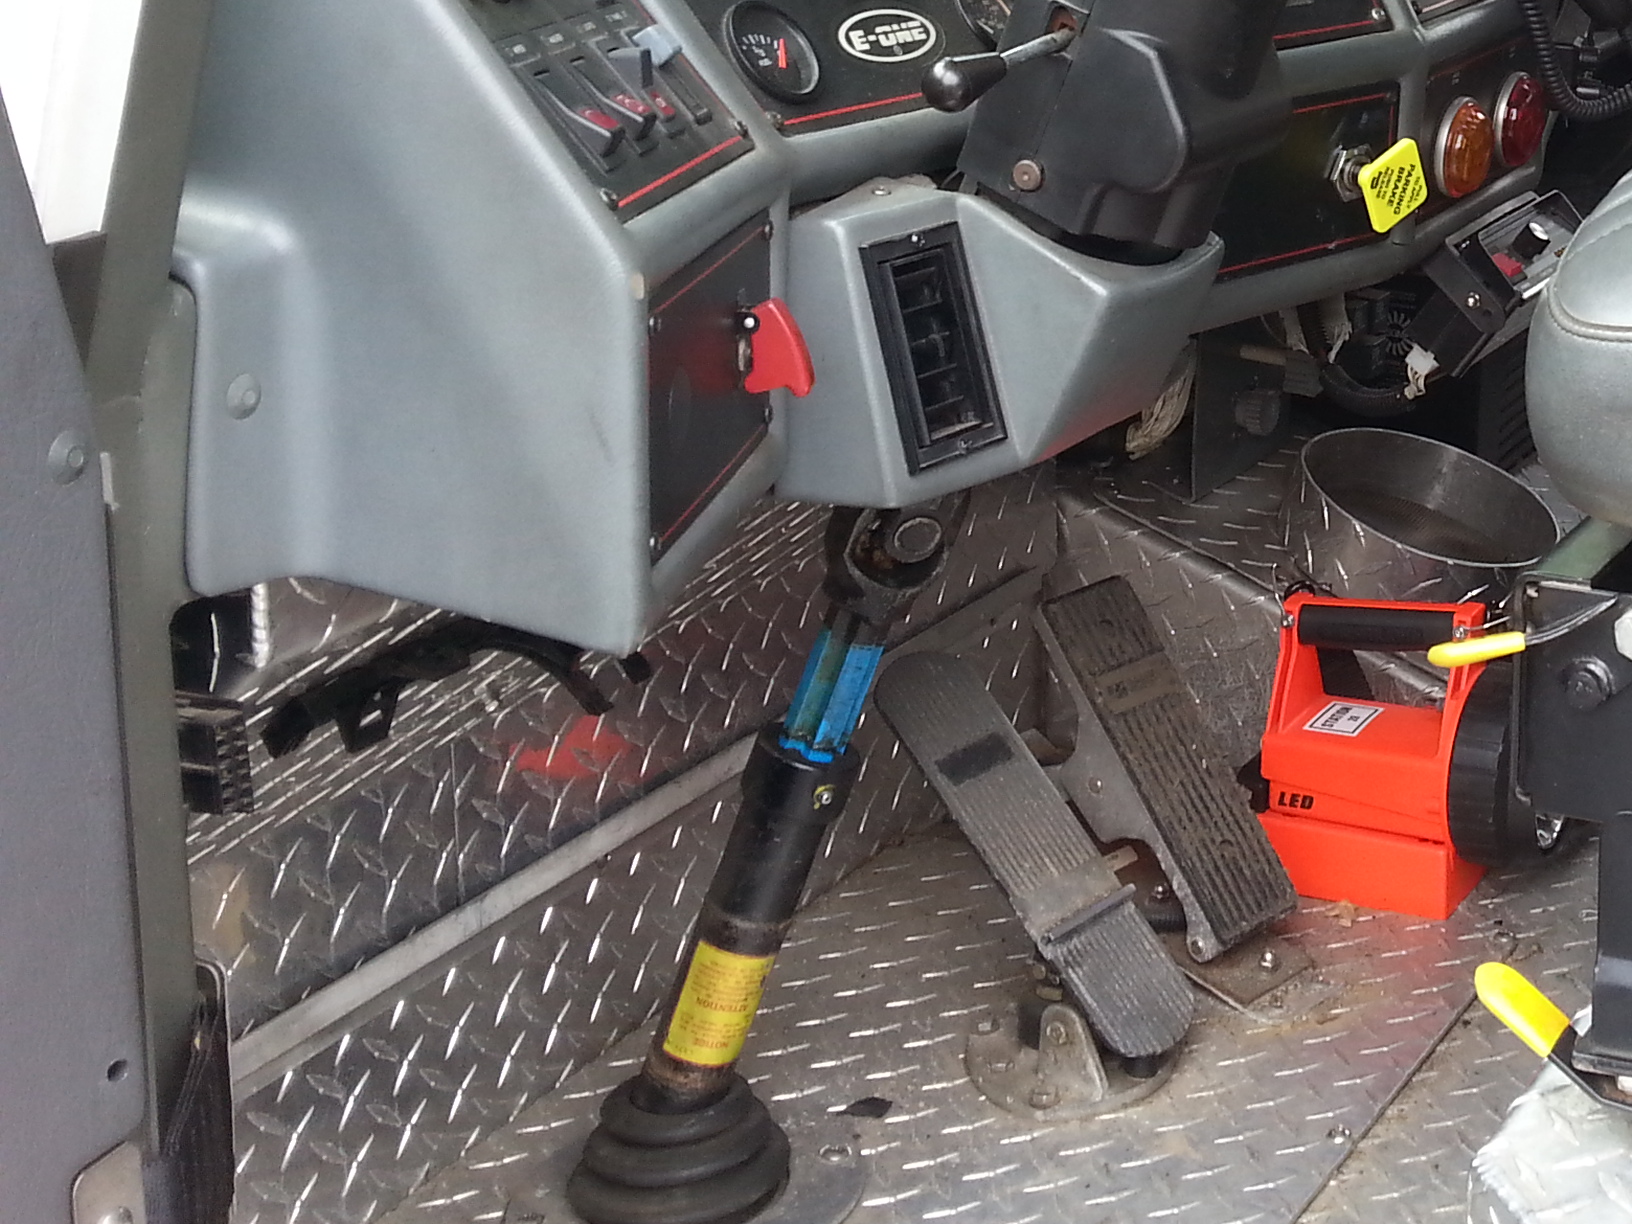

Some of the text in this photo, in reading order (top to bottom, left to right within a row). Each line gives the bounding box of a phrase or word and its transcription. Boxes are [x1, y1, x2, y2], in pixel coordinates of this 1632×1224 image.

[1386, 166, 1406, 207] BRAKE
[1393, 163, 1416, 215] PARKING
[1277, 790, 1315, 810] LED
